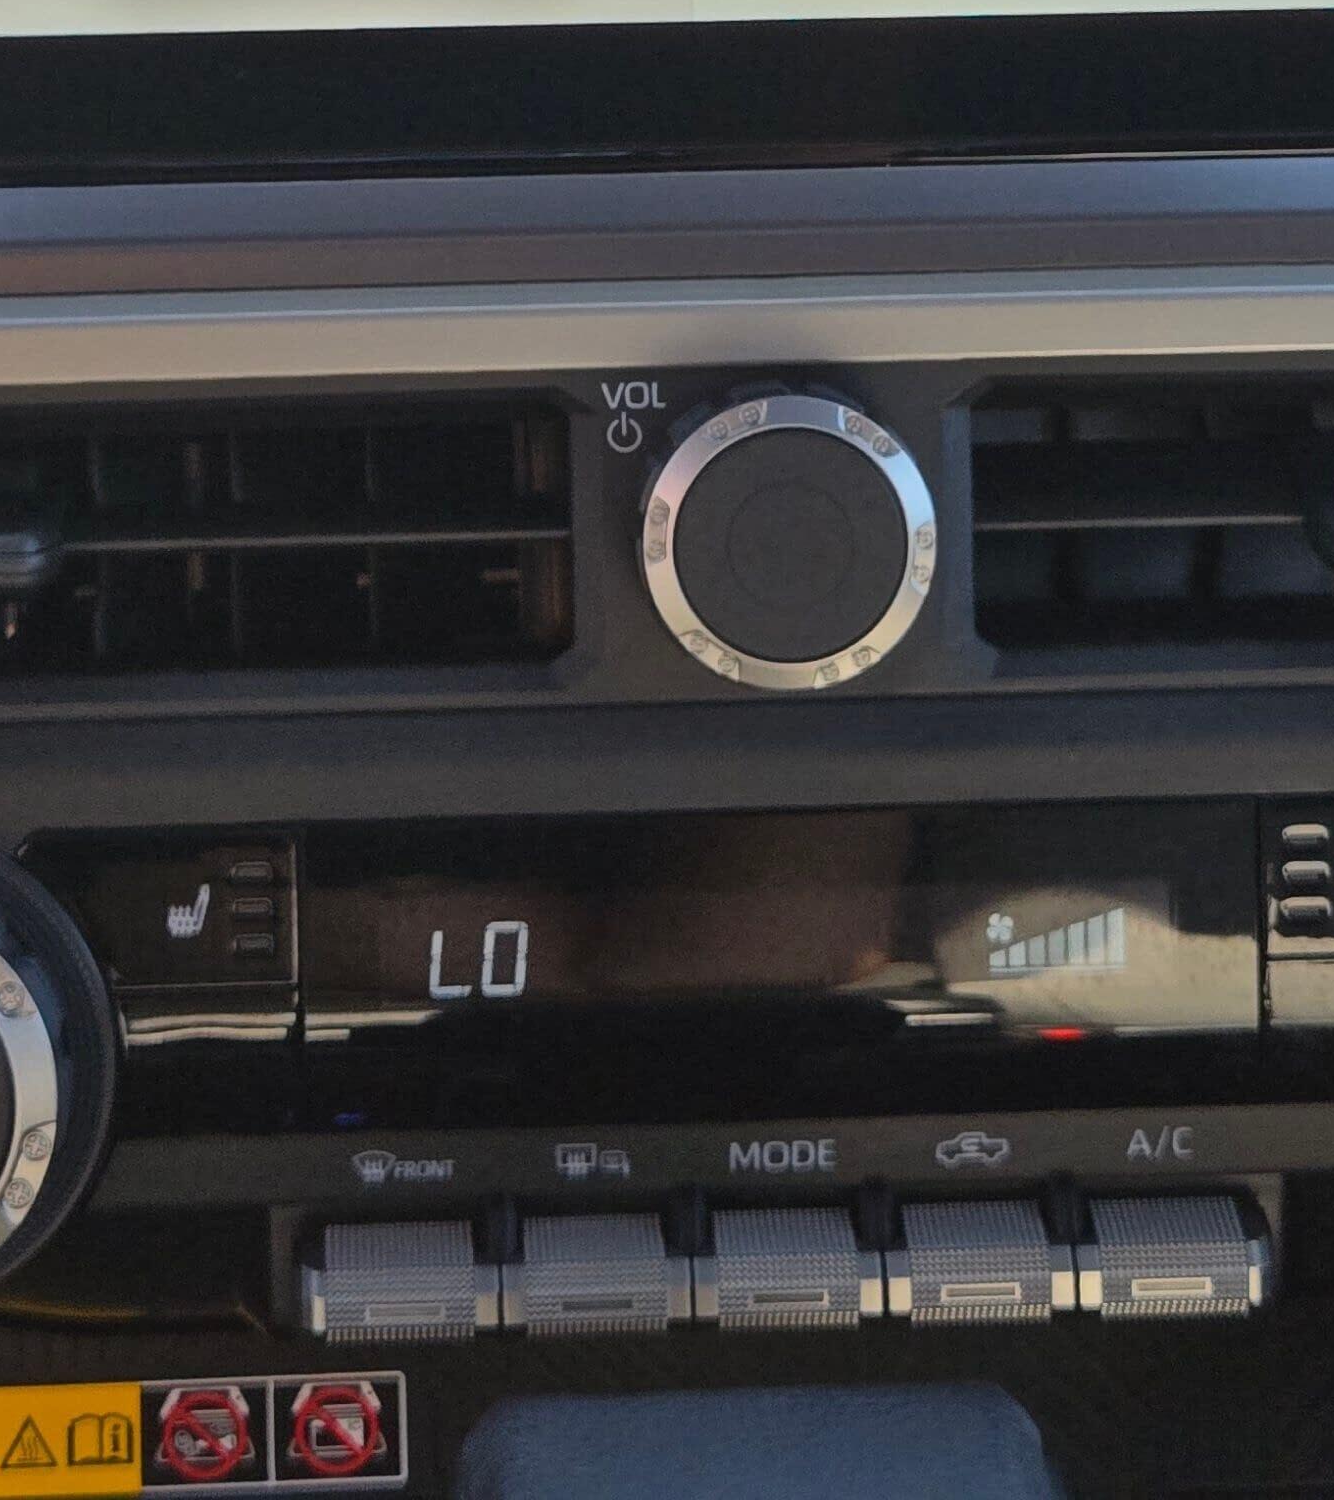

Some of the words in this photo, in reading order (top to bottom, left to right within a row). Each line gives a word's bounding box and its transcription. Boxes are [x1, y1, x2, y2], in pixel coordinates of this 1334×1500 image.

[601, 381, 667, 410] VOL
[729, 1138, 837, 1172] MODE
[1127, 1125, 1193, 1159] A/C
[394, 1159, 455, 1182] FRONT
